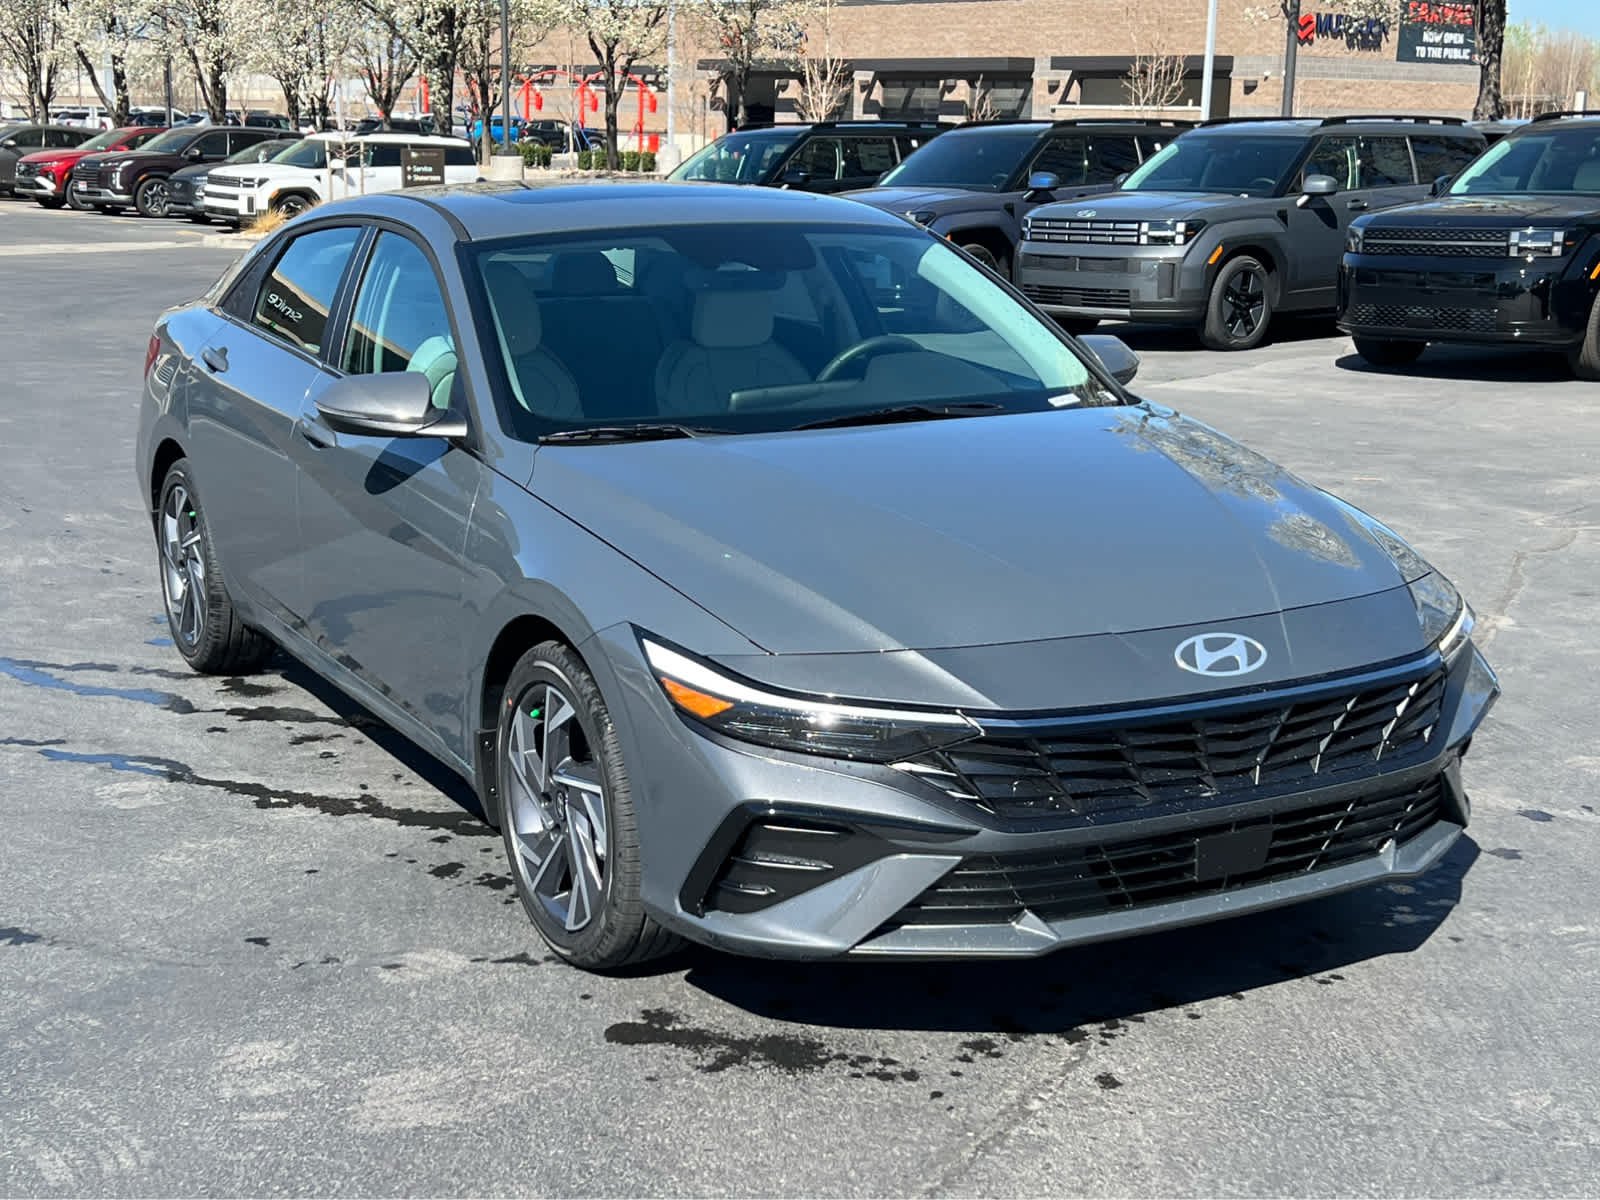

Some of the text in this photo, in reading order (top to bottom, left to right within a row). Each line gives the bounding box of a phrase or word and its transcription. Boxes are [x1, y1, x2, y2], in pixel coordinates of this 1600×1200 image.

[1423, 31, 1464, 44] NOW OPEN
[1416, 46, 1470, 59] TO THE PUBLIC
